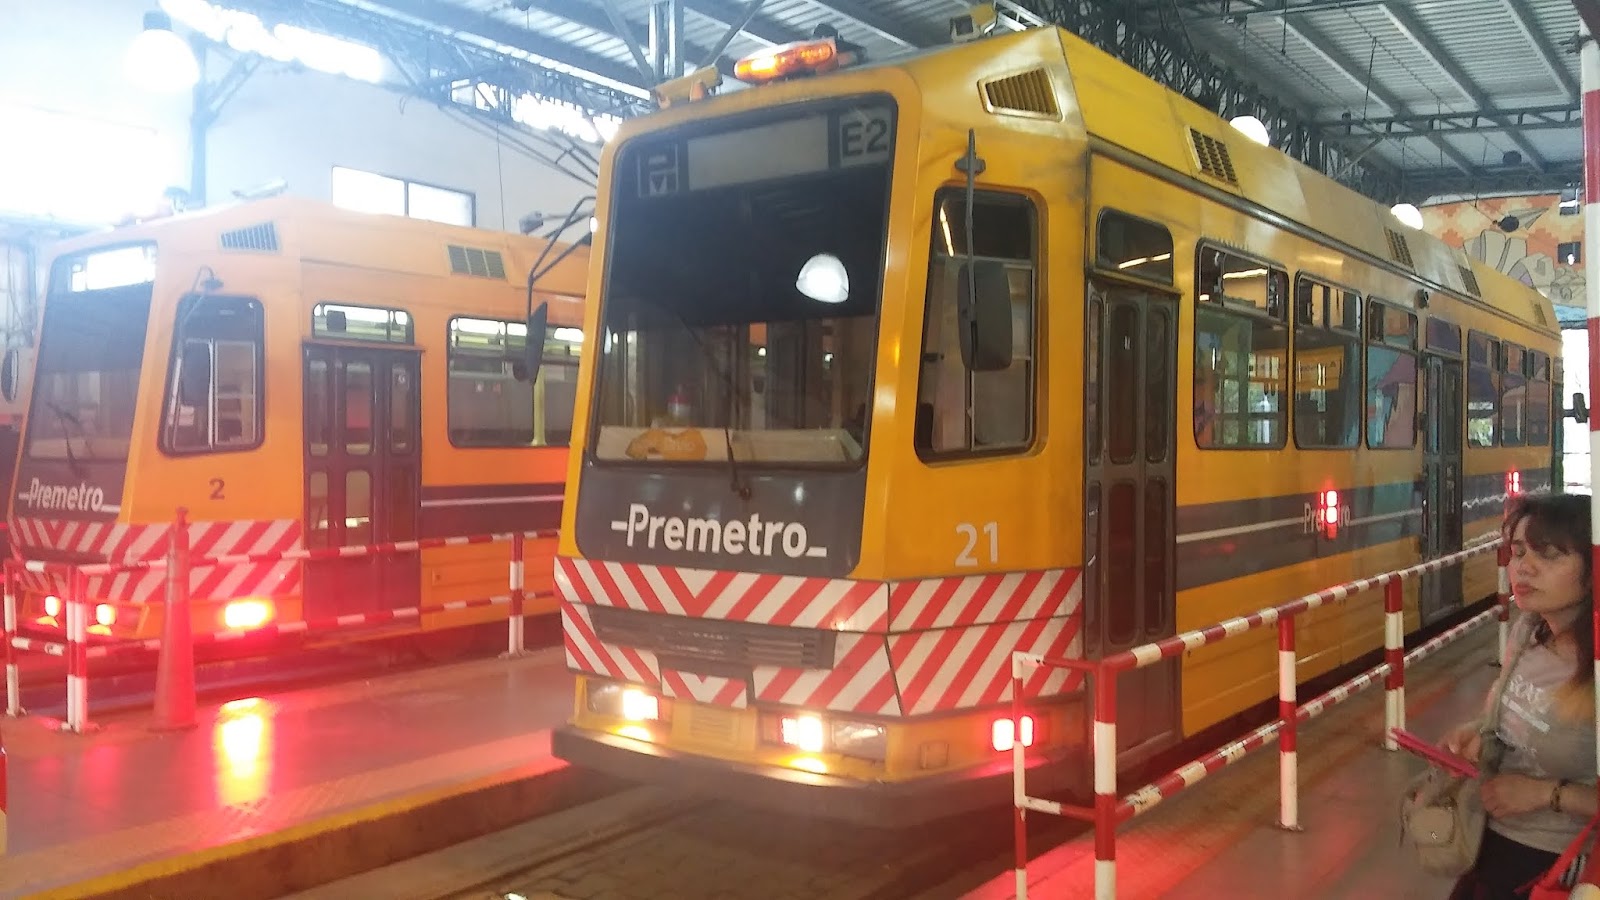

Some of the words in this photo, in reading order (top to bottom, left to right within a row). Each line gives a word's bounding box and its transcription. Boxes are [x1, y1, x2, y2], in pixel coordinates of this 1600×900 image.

[841, 118, 888, 157] E2
[28, 477, 104, 512] Premetro
[208, 478, 226, 500] 2
[626, 503, 808, 558] Premetro
[1303, 502, 1350, 534] Pretro
[954, 521, 999, 567] 21
